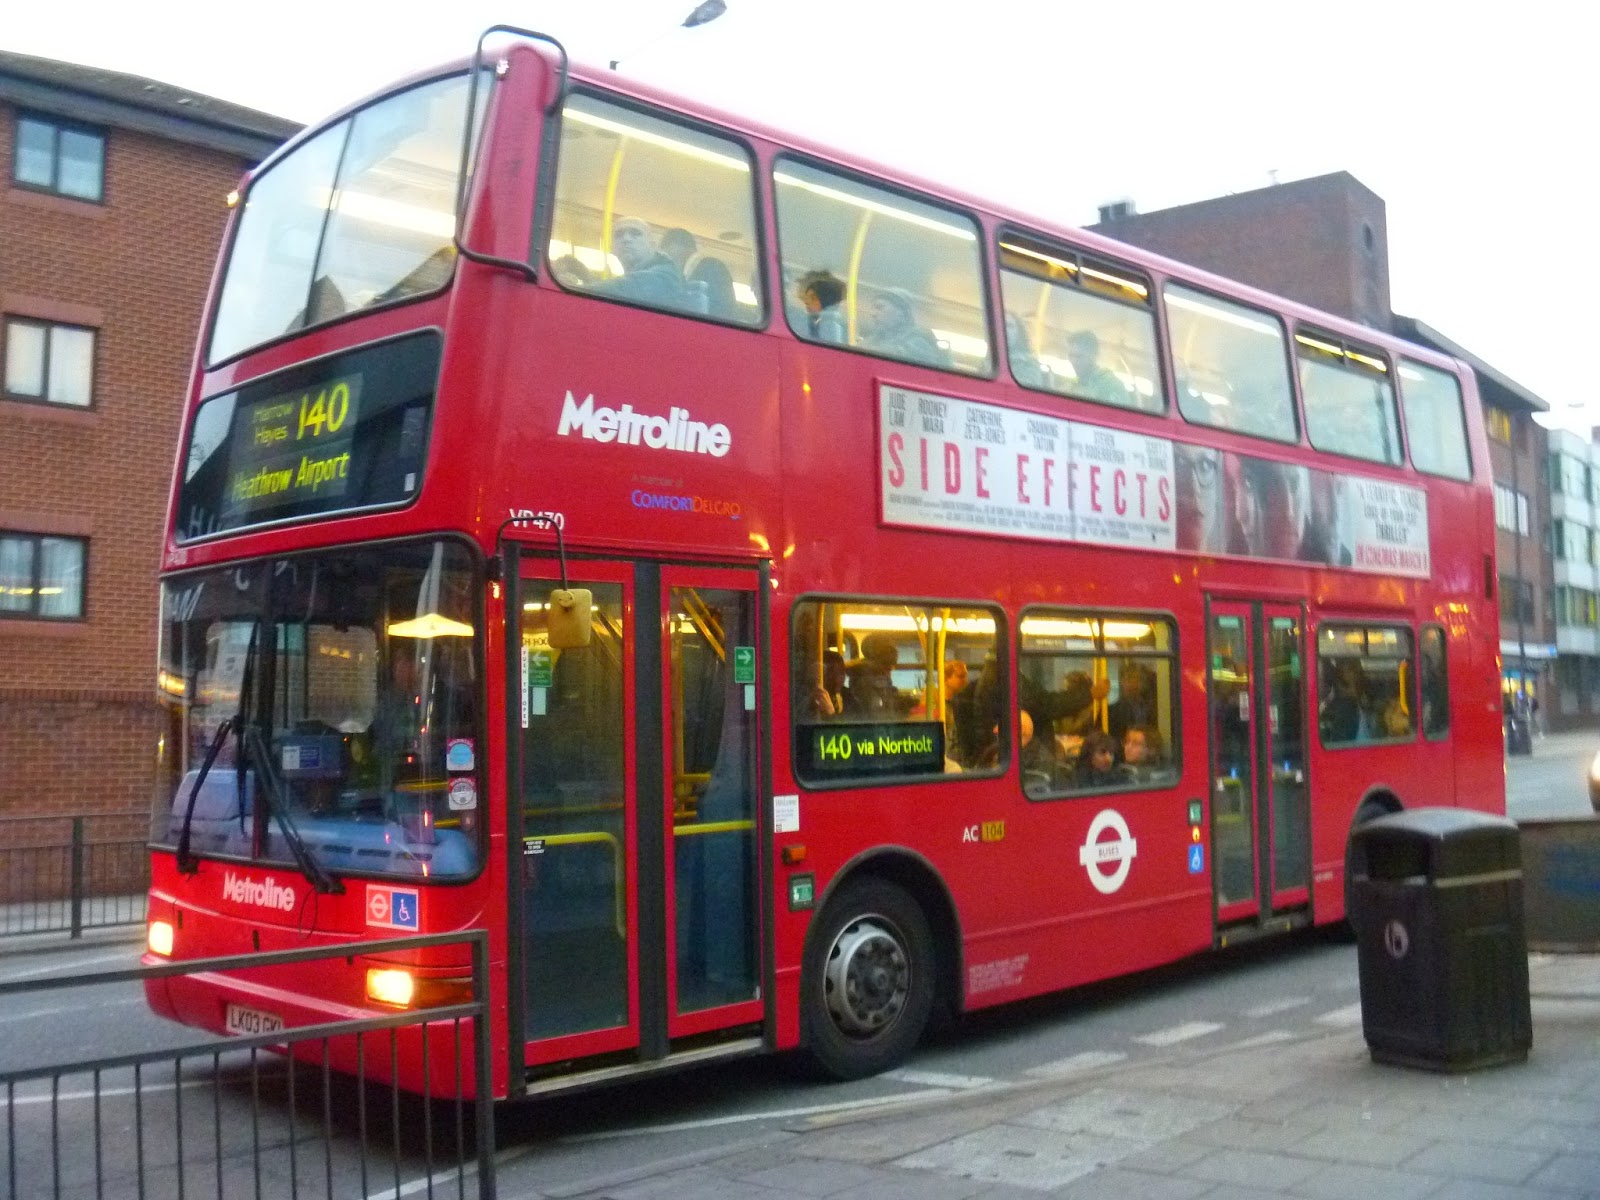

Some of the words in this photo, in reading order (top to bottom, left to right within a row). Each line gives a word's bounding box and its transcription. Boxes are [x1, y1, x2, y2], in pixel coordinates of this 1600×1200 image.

[297, 382, 349, 440] 140
[557, 389, 732, 458] Metroline
[254, 425, 288, 447] Hayes
[232, 467, 293, 502] Heathrow
[295, 452, 350, 494] Airport
[888, 432, 990, 498] SIDE
[1017, 453, 1171, 522] EFFECTS
[508, 508, 564, 530] VP470
[820, 734, 852, 760] 140
[857, 738, 875, 755] via
[878, 734, 933, 755] Northolt
[963, 825, 979, 843] AC
[1098, 845, 1120, 857] BUSES
[222, 871, 295, 912] Metroline
[230, 1007, 260, 1034] LK03
